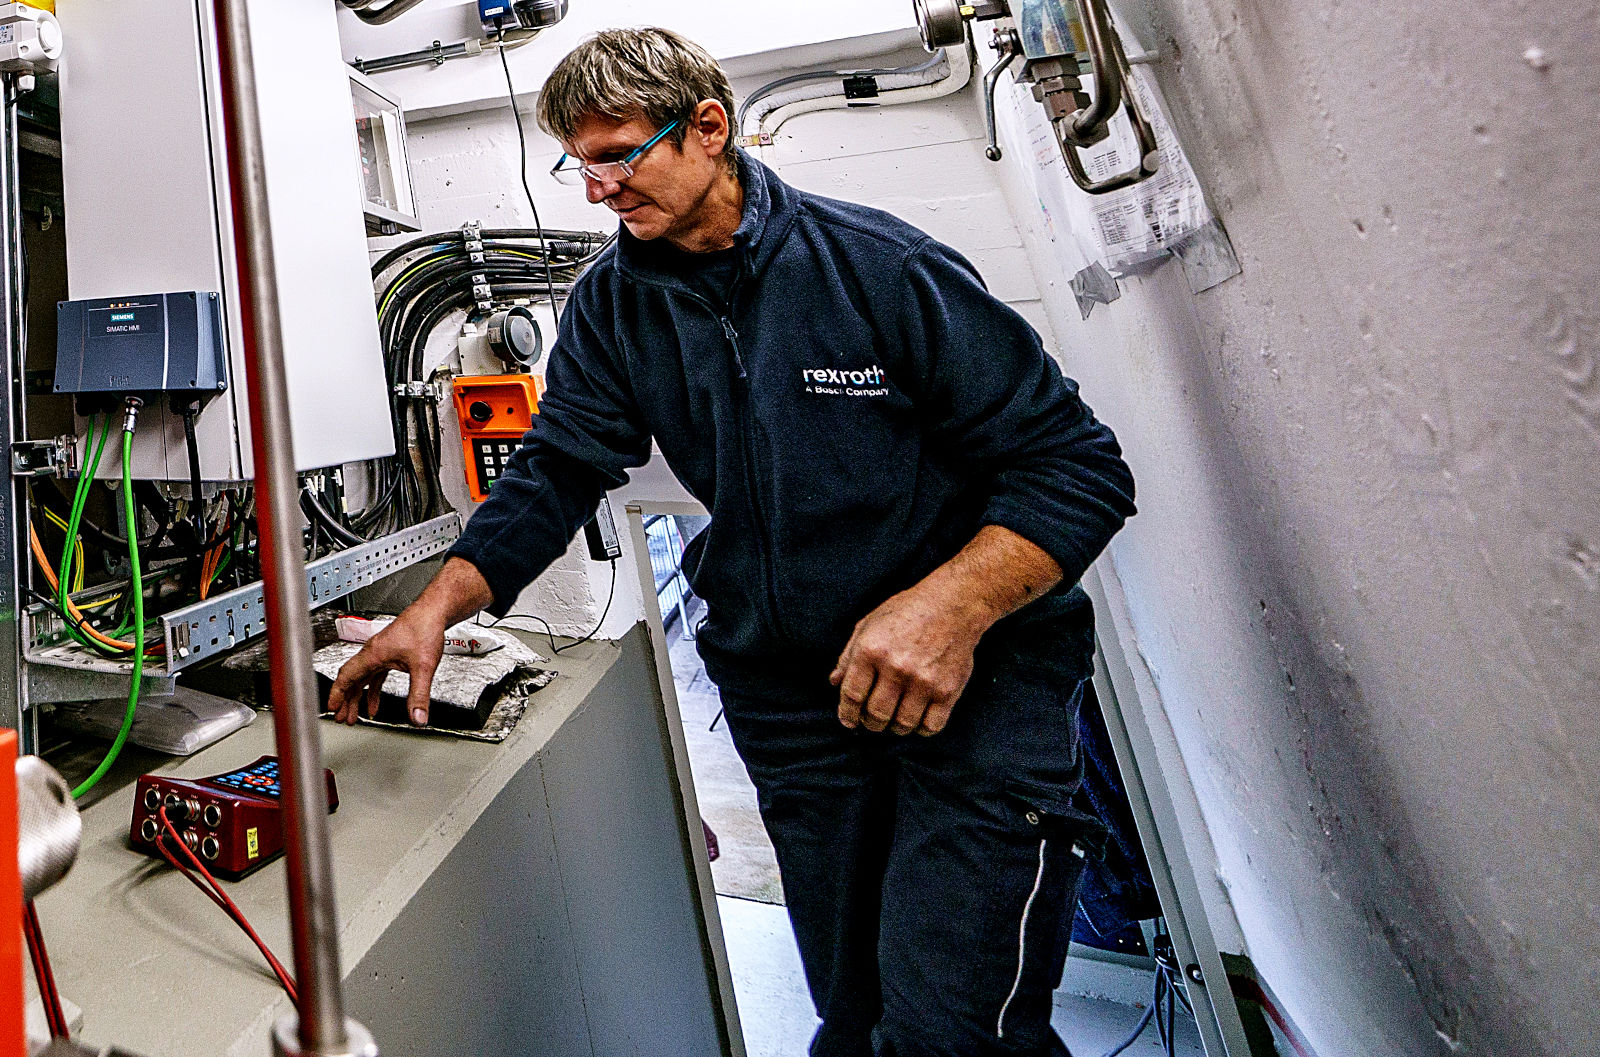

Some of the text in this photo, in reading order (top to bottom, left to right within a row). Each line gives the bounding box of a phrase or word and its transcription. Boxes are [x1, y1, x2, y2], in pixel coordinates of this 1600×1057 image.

[106, 325, 128, 333] SIMATIC
[802, 364, 886, 385] rexroth
[805, 385, 813, 393] A
[845, 387, 889, 397] Company
